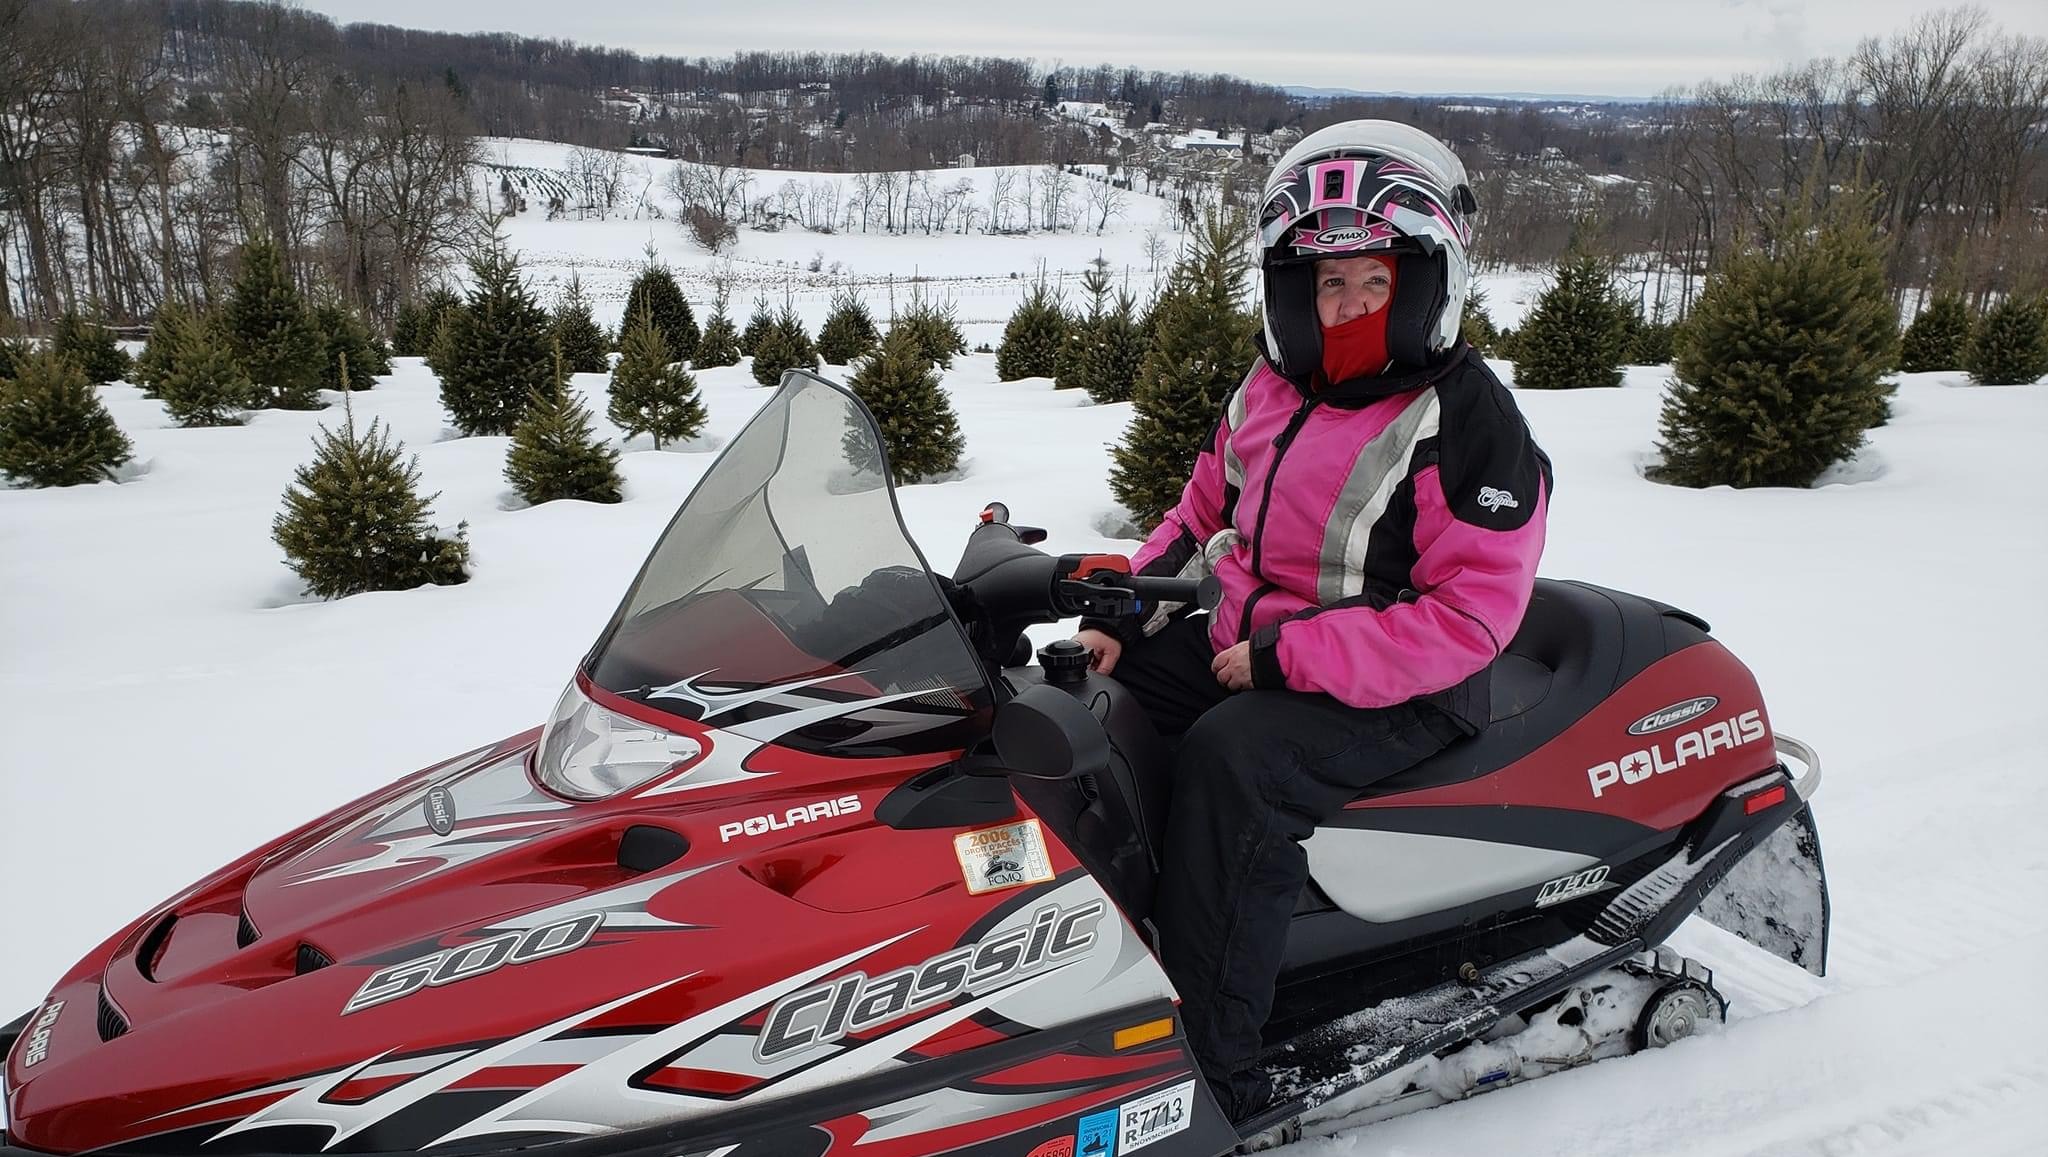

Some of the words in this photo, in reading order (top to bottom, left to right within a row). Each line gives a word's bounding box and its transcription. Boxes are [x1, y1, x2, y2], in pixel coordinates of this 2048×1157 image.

[1315, 228, 1368, 244] GMAX
[1641, 701, 1707, 732] Classic
[1588, 709, 1766, 798] POLARIS
[430, 791, 450, 825] Classic
[719, 794, 862, 843] POLARIS
[964, 845, 988, 856] DROIT
[969, 830, 1010, 847] 2006
[987, 871, 1023, 886] FCMQ
[343, 911, 605, 1014] 500
[750, 900, 1104, 1060] Classic
[25, 1000, 66, 1068] POLARIS
[1140, 1097, 1183, 1136] 7713
[1129, 1125, 1180, 1149] SNOWMOBILE
